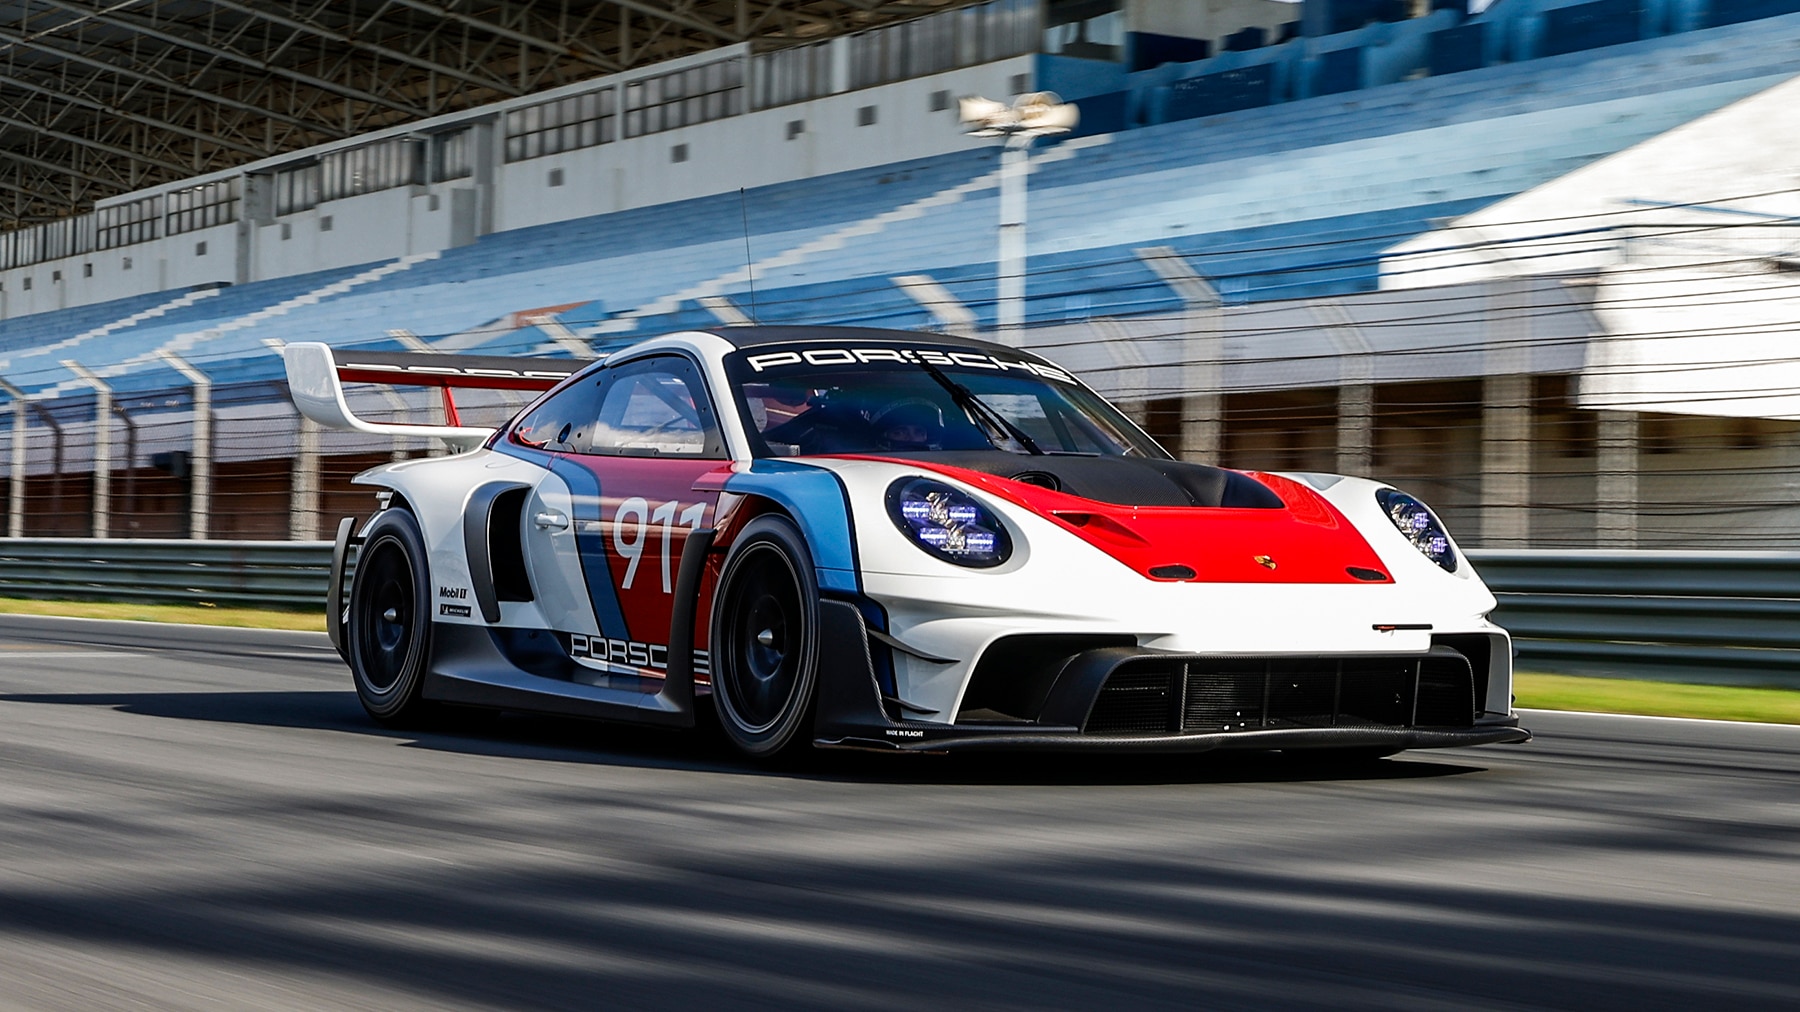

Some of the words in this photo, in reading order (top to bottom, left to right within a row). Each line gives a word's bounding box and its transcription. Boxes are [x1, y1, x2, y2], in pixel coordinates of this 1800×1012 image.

[747, 349, 1078, 386] PORSCHE
[440, 587, 459, 598] Mobil
[571, 633, 710, 674] PORSCE
